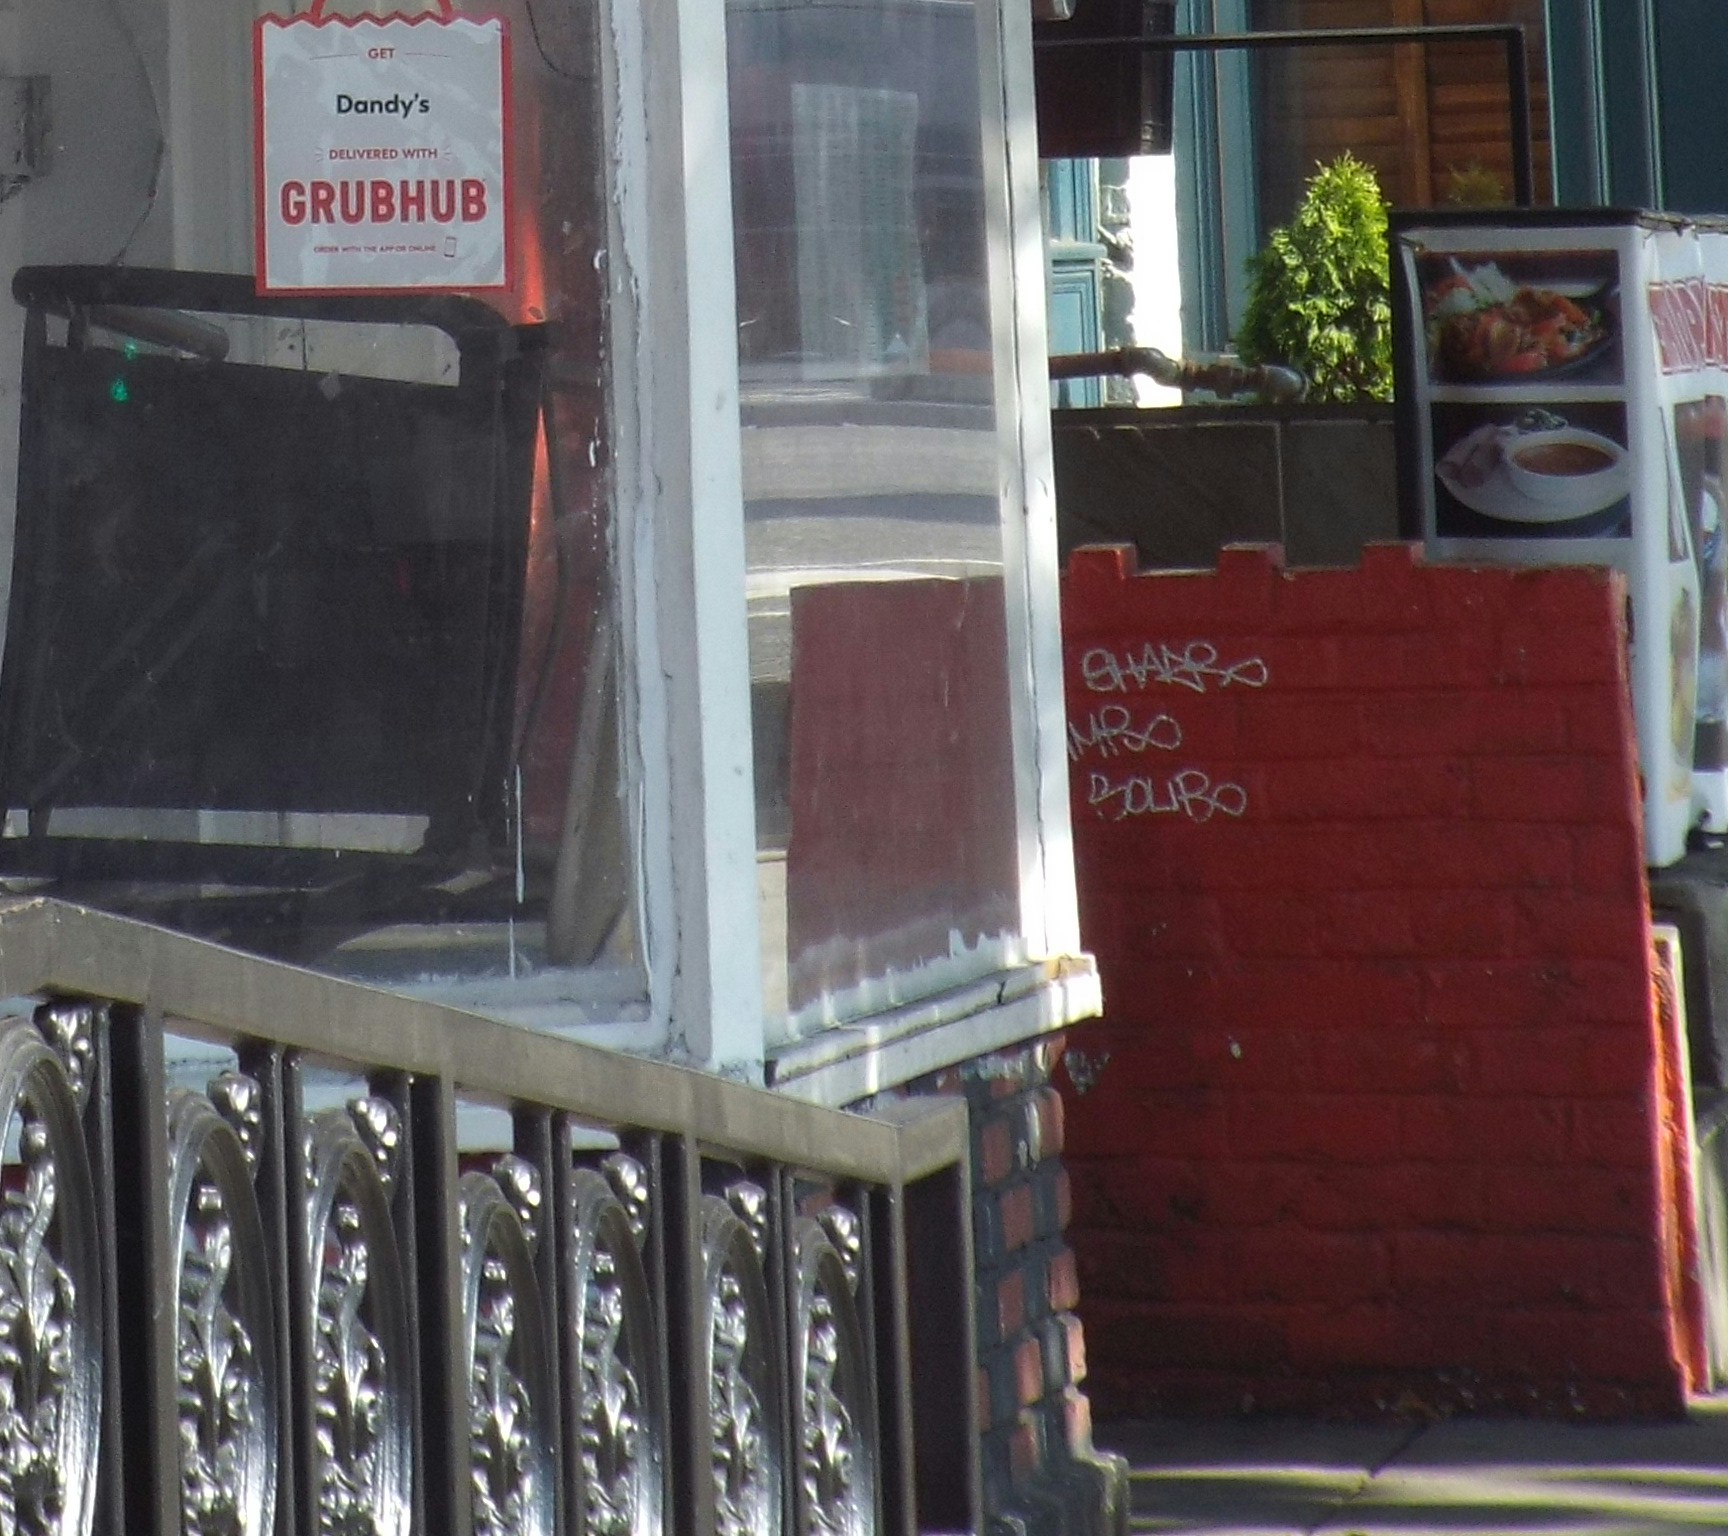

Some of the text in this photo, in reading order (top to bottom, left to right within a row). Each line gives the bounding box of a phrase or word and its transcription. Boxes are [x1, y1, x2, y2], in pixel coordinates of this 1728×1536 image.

[367, 48, 395, 59] GET
[336, 93, 430, 118] Dandy's
[328, 148, 438, 160] DELIVERED WITH
[281, 179, 488, 225] GRUBHUB
